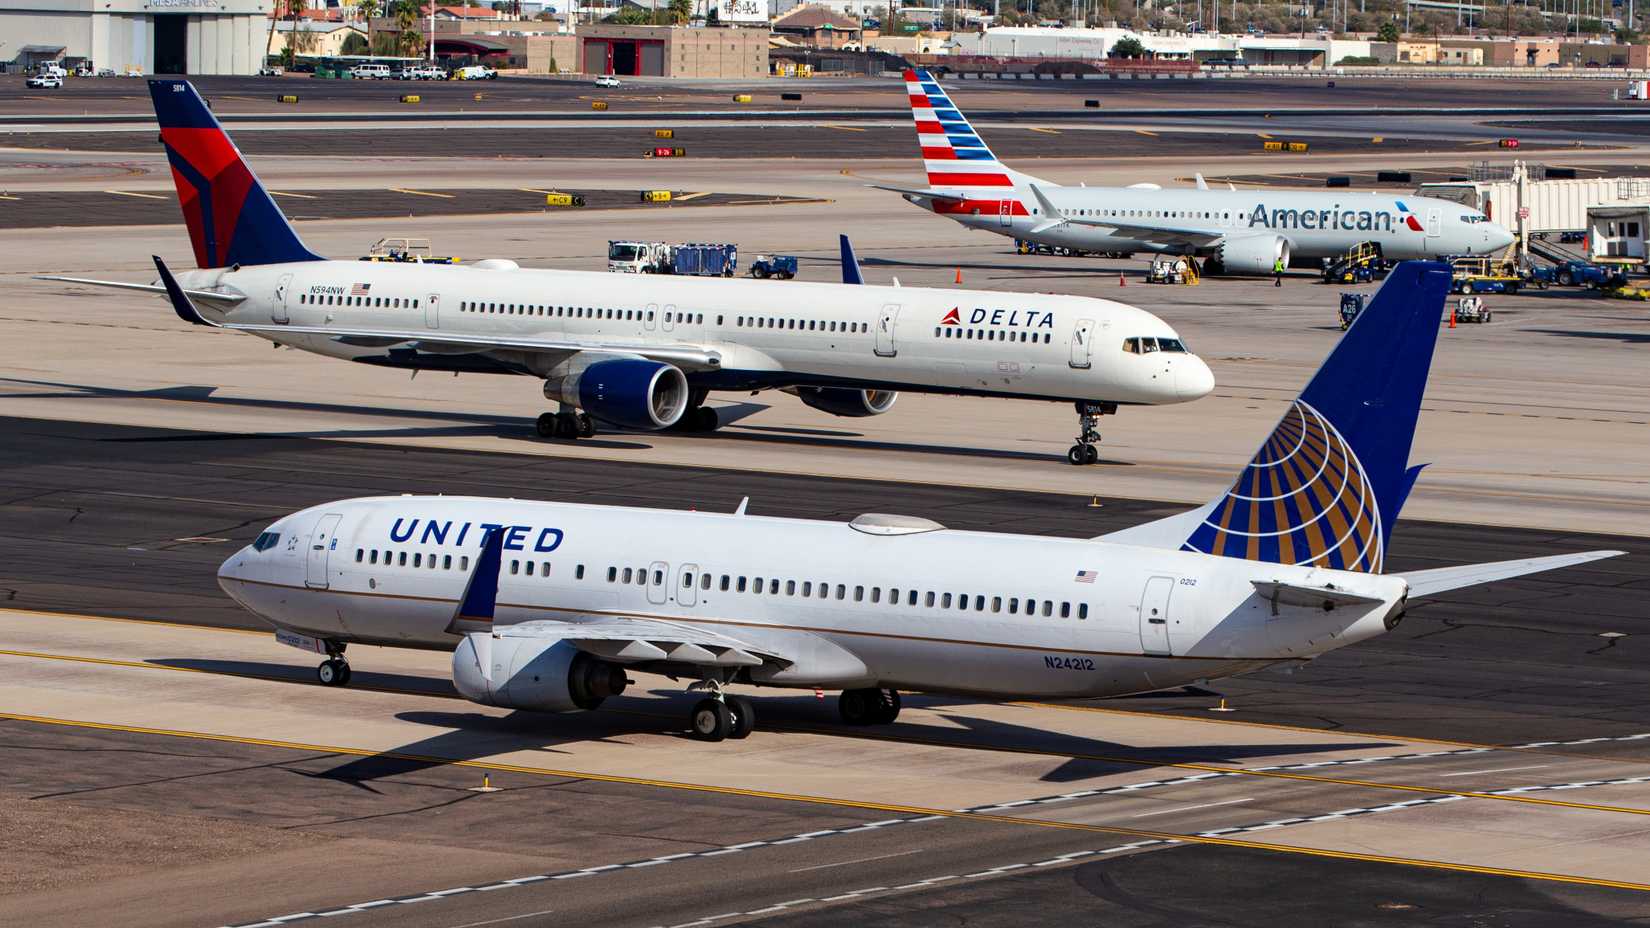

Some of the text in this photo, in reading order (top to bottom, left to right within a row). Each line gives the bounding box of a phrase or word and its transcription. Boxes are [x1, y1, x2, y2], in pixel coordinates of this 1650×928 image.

[1248, 204, 1391, 231] American
[310, 285, 345, 295] N594NW
[969, 308, 1053, 328] DELTA
[389, 518, 564, 552] UNITED
[1044, 656, 1096, 671] N24212
